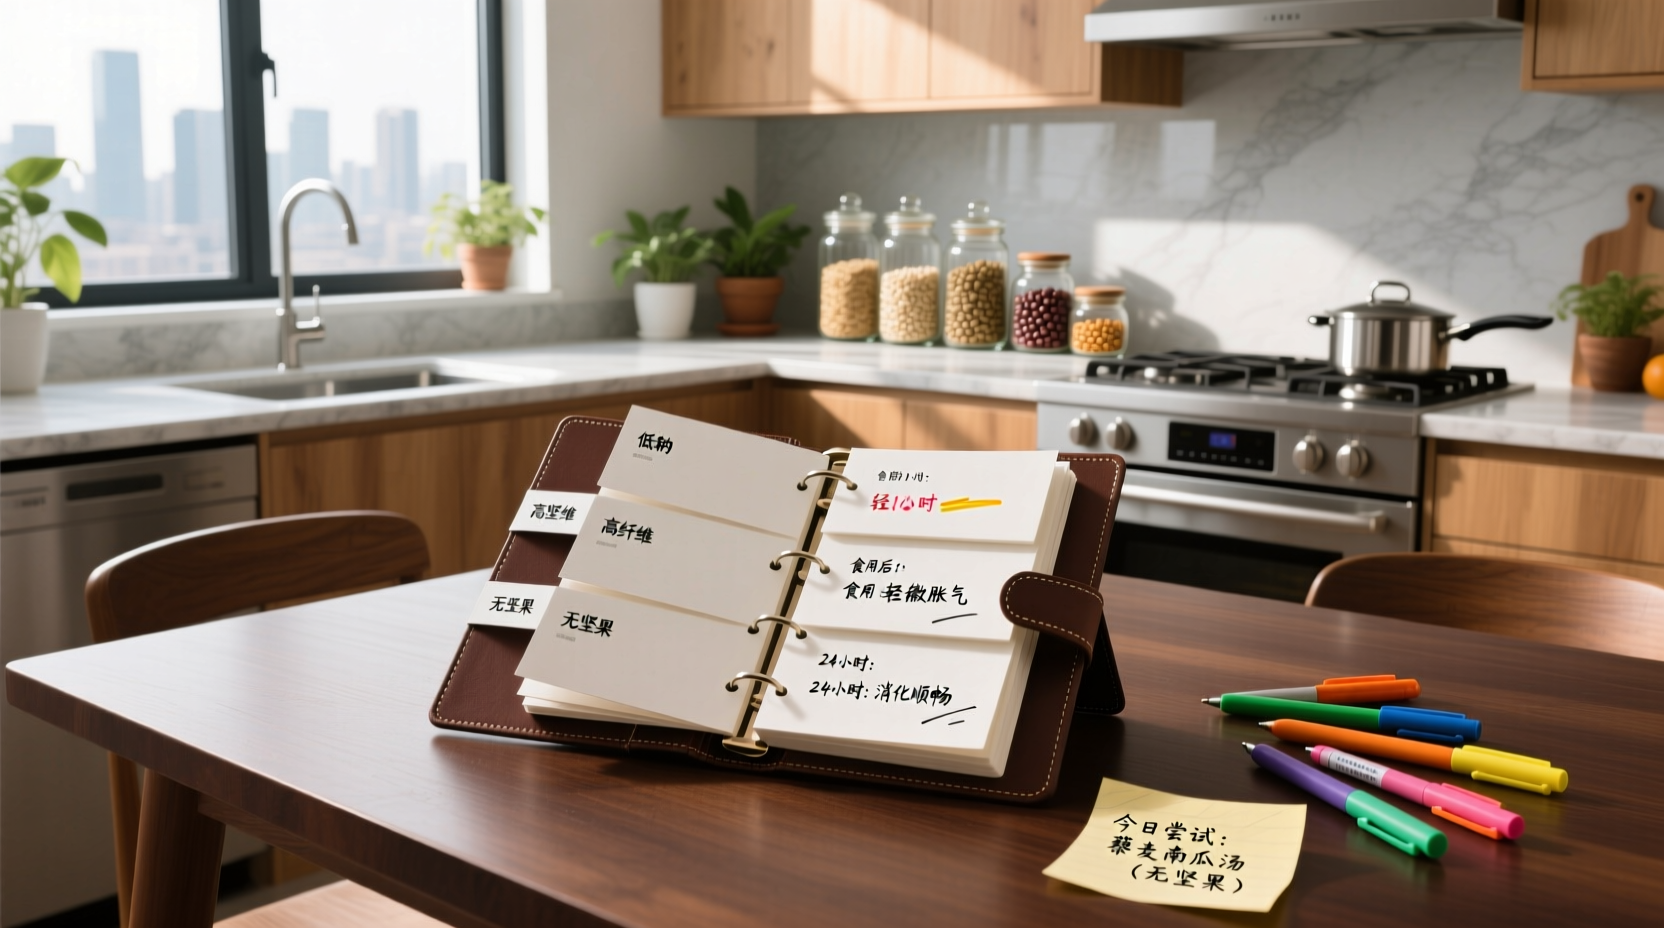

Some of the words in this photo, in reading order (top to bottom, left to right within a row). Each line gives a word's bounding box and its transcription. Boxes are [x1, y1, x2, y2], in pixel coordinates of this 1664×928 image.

[601, 517, 654, 544] 高纤维
[489, 596, 535, 615] 无坚果
[560, 611, 614, 637] 无坚果
[1113, 813, 1227, 846] 今日尝试：
